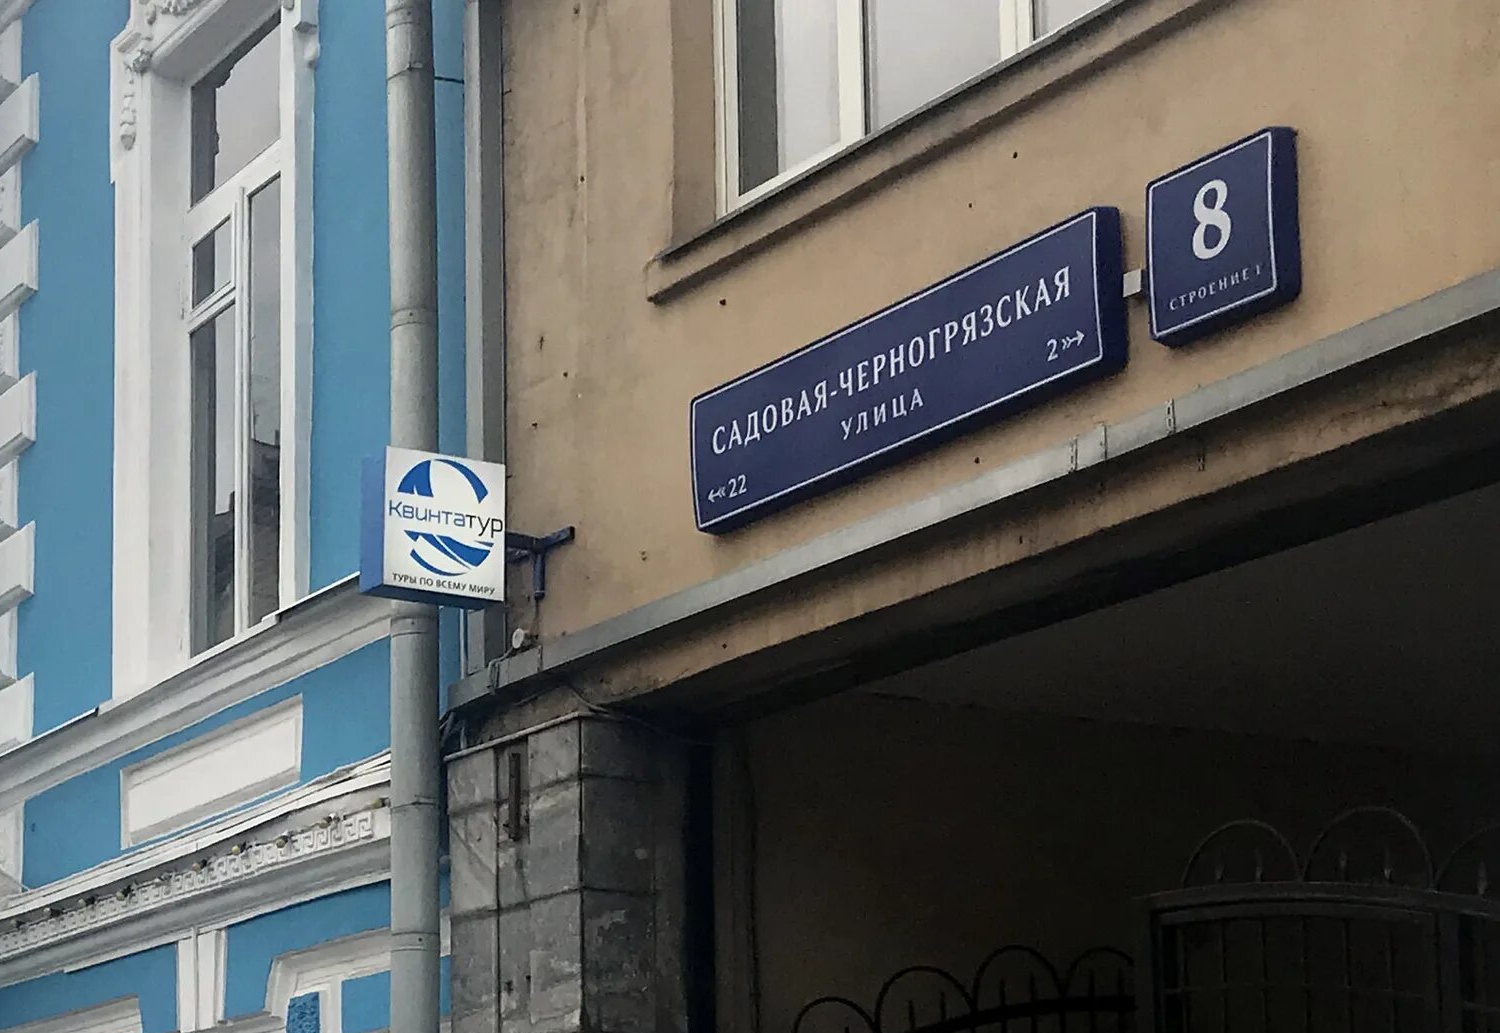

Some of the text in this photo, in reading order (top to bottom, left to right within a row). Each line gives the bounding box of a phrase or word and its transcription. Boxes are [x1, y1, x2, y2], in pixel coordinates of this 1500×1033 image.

[1192, 179, 1232, 260] 8
[1169, 267, 1250, 311] СТРОЕНИЕ
[711, 265, 1071, 455] САДОВАЯ-ЧЕРНОГРЯЗСКАЯ
[1046, 338, 1059, 362] 2
[840, 387, 924, 441] УЛИЦА
[727, 474, 748, 498] 22
[388, 499, 504, 538] Квинтатур
[392, 572, 496, 595] ТУРЫ ПО ВСЕМУ МИРУ
